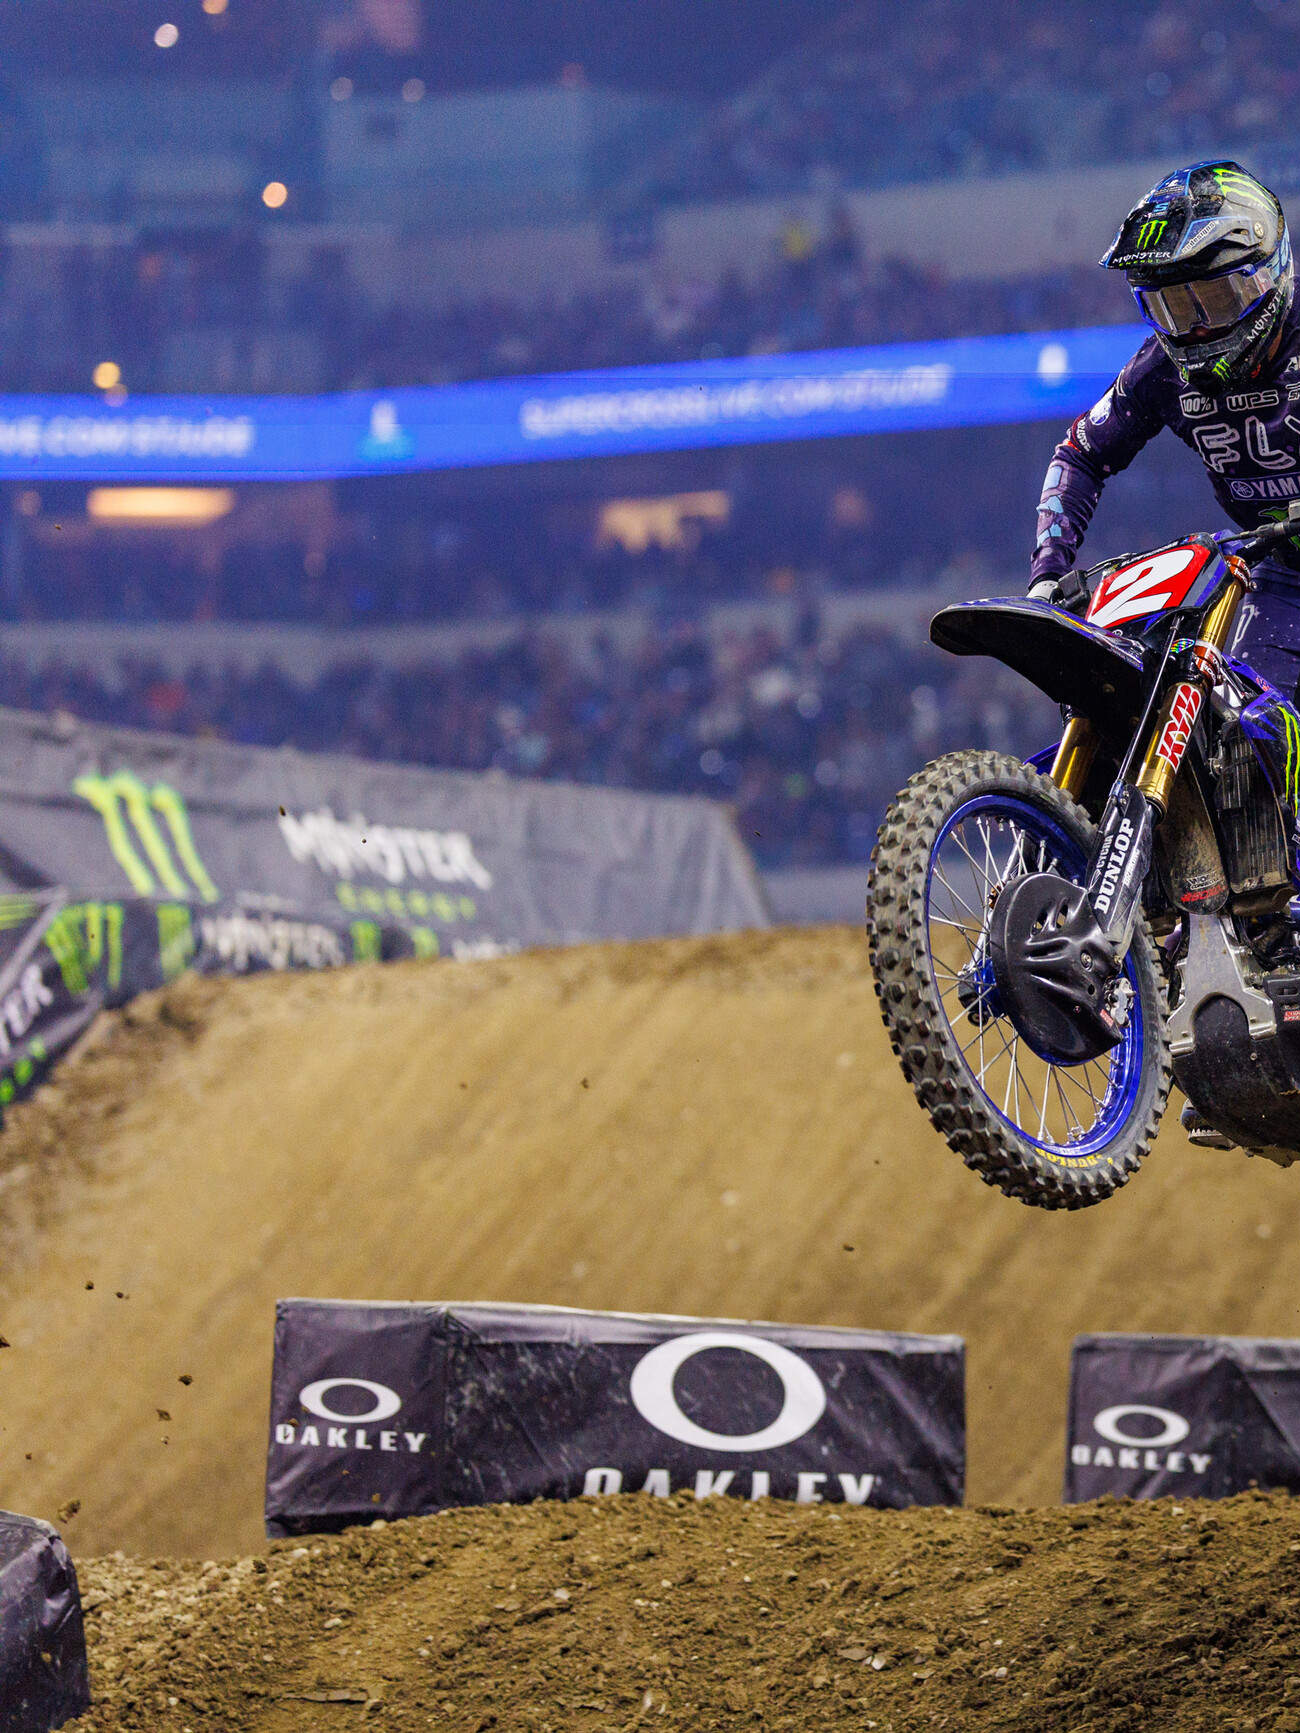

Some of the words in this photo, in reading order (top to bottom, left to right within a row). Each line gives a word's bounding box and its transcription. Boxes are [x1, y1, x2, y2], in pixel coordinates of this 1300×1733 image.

[1183, 396, 1212, 414] 100%
[1226, 390, 1279, 412] WPS
[1088, 549, 1195, 629] 2
[1156, 684, 1202, 774] KYB
[1094, 818, 1134, 915] DUNLOP
[1097, 834, 1114, 870] CYCRA
[275, 1423, 426, 1453] OAKLEY
[1071, 1444, 1211, 1474] OAKLEY
